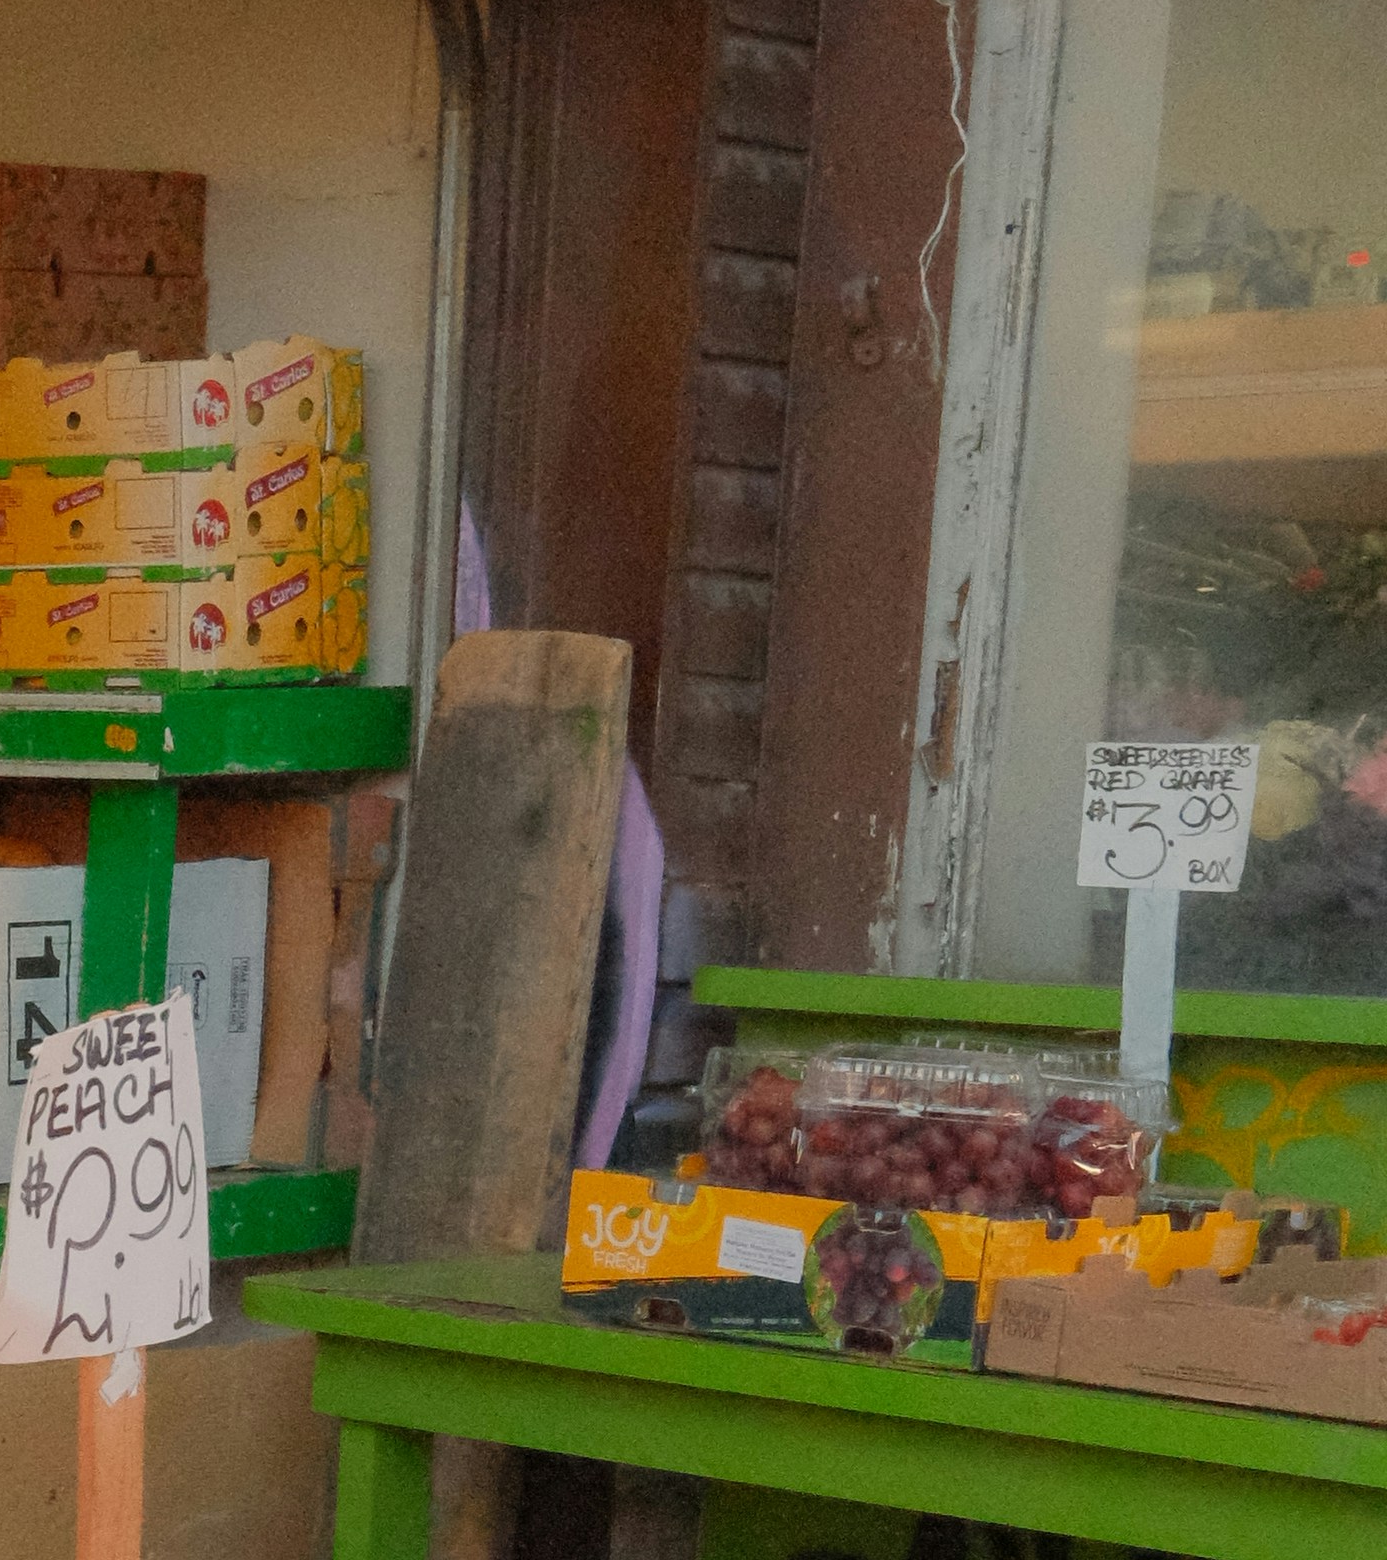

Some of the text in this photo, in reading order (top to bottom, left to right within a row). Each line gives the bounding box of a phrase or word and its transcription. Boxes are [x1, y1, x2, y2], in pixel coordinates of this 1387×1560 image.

[1088, 769, 1242, 791] RED GRAPE
[1188, 857, 1231, 884] BOX
[63, 1010, 170, 1074] SWEET
[27, 1058, 175, 1144] PEACH
[593, 1251, 647, 1274] FRESH
